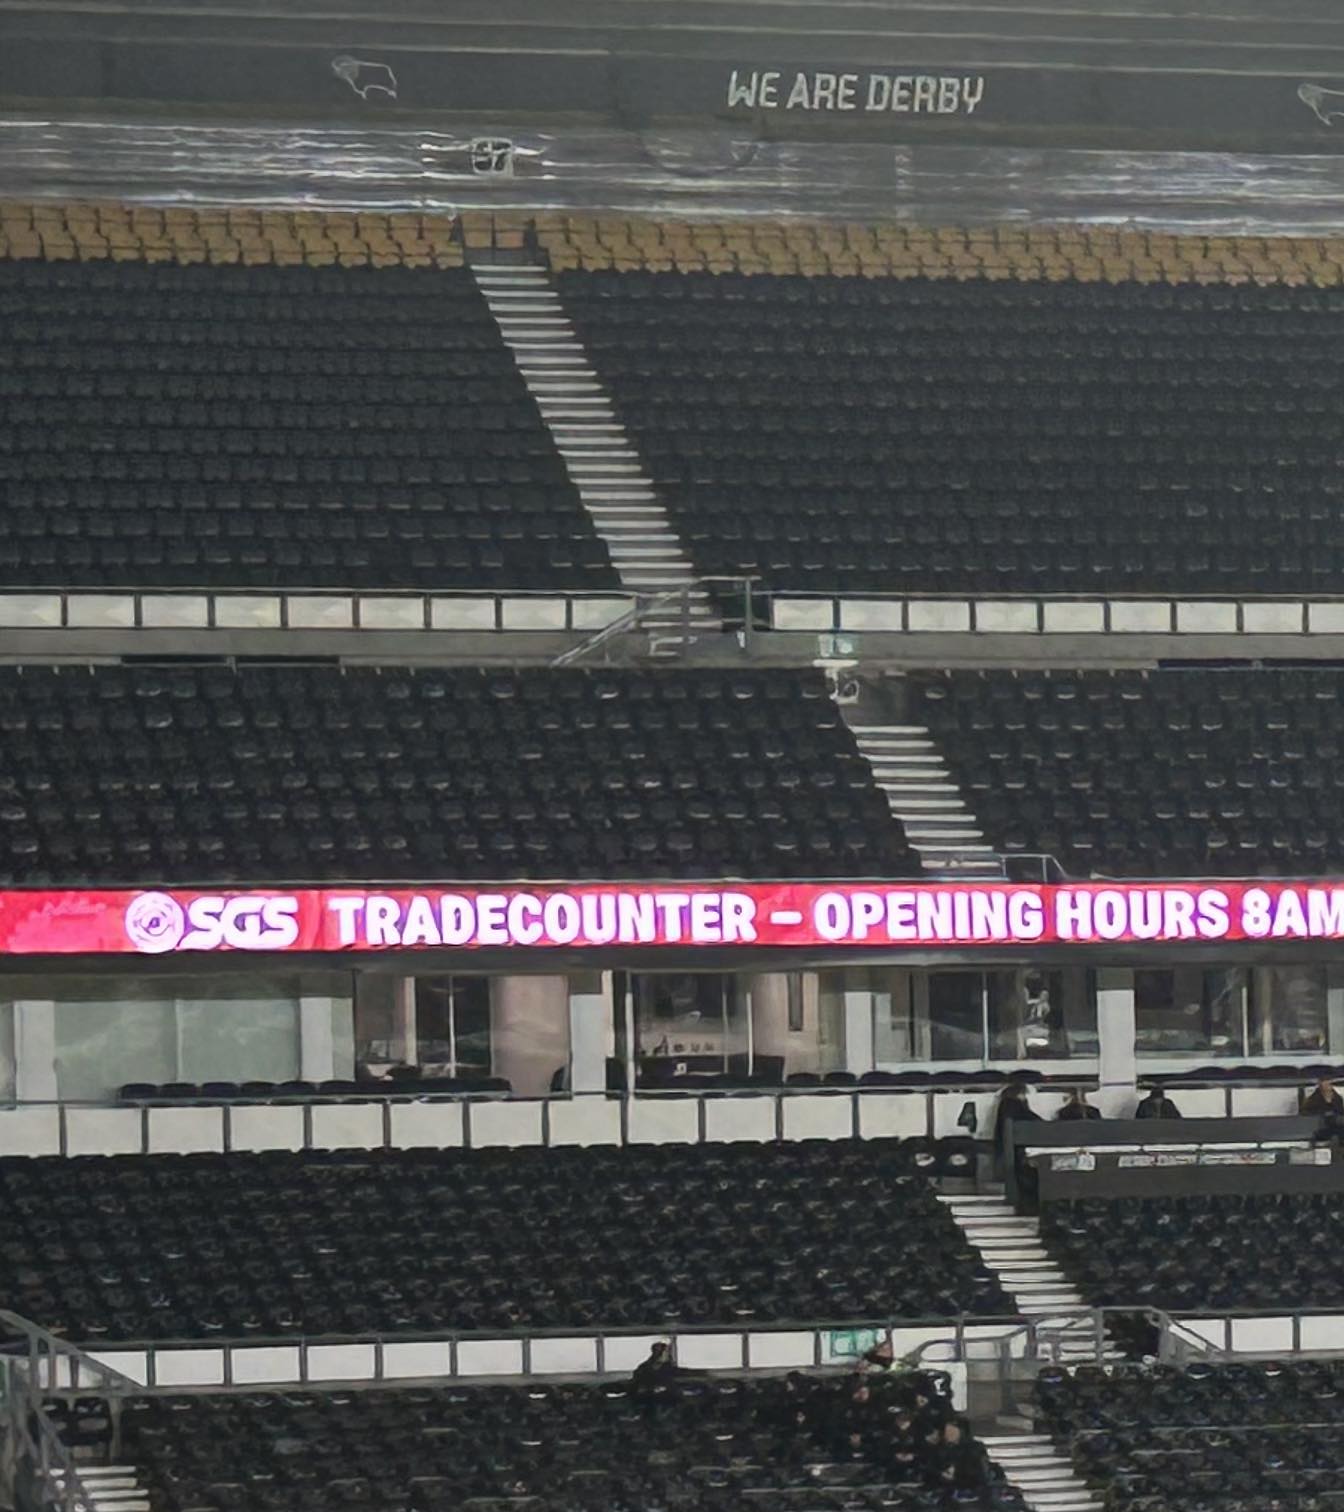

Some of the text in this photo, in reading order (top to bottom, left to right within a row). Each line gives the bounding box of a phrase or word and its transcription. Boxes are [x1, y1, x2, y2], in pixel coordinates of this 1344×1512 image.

[728, 71, 984, 113] WE ARE DERBY
[180, 896, 298, 948] SGS
[329, 892, 757, 947] TRADECOUNTER
[813, 888, 1044, 941] OPENING
[1056, 888, 1230, 939] HOURS
